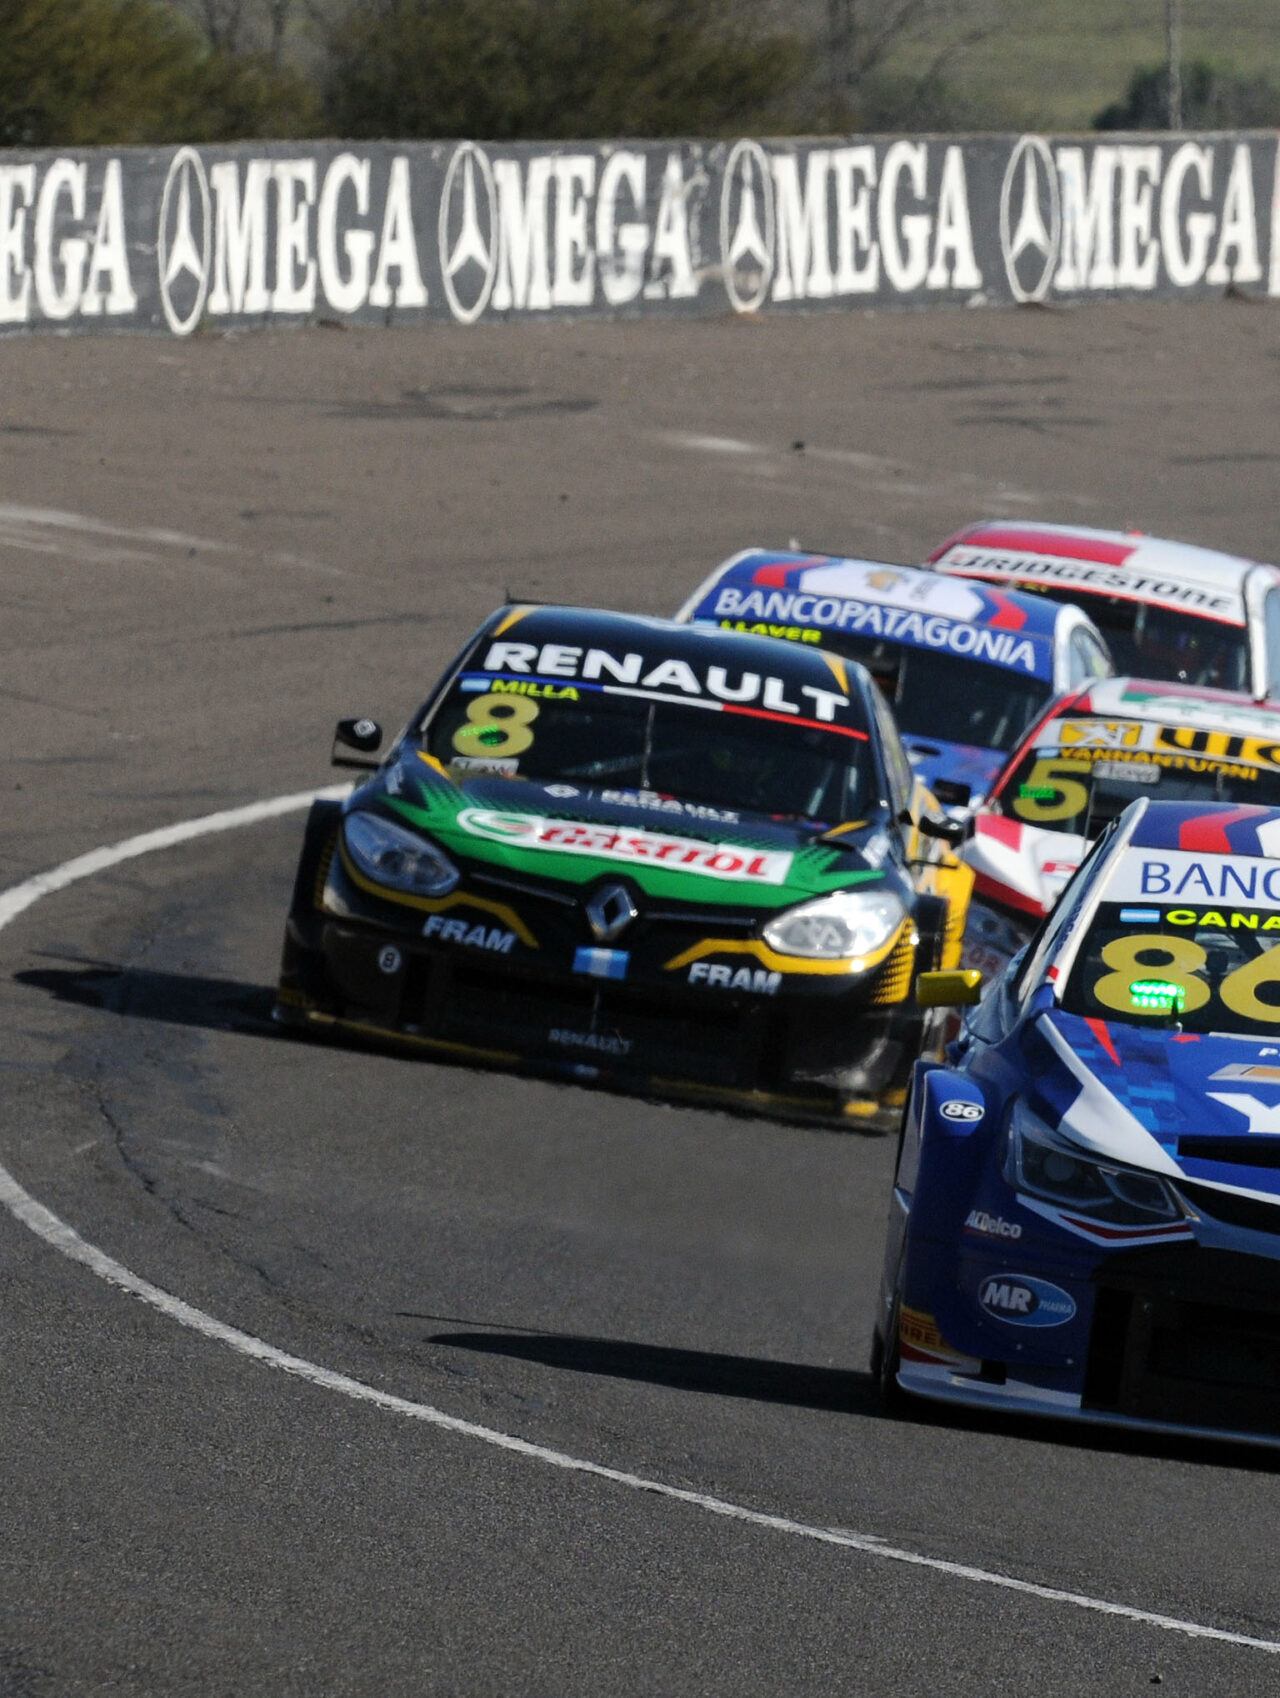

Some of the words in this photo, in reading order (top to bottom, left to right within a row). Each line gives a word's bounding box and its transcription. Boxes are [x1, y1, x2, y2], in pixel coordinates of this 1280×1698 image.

[208, 153, 427, 313] MEGA
[491, 152, 699, 309] MEGA
[770, 141, 983, 301] MEGA
[1052, 142, 1261, 291] MEGA
[949, 550, 1236, 611] BRIDGESTONE
[714, 586, 1036, 673] BANCOPATAGONIA
[484, 641, 850, 722] RENAULT
[490, 679, 580, 701] MILLA
[452, 693, 540, 758] 8
[1012, 758, 1092, 822] 5
[422, 914, 517, 953] FRAM
[687, 962, 782, 995] FRAM
[945, 1103, 980, 1118] 86
[964, 1209, 1022, 1240] ACDelco
[983, 1281, 1032, 1312] MR
